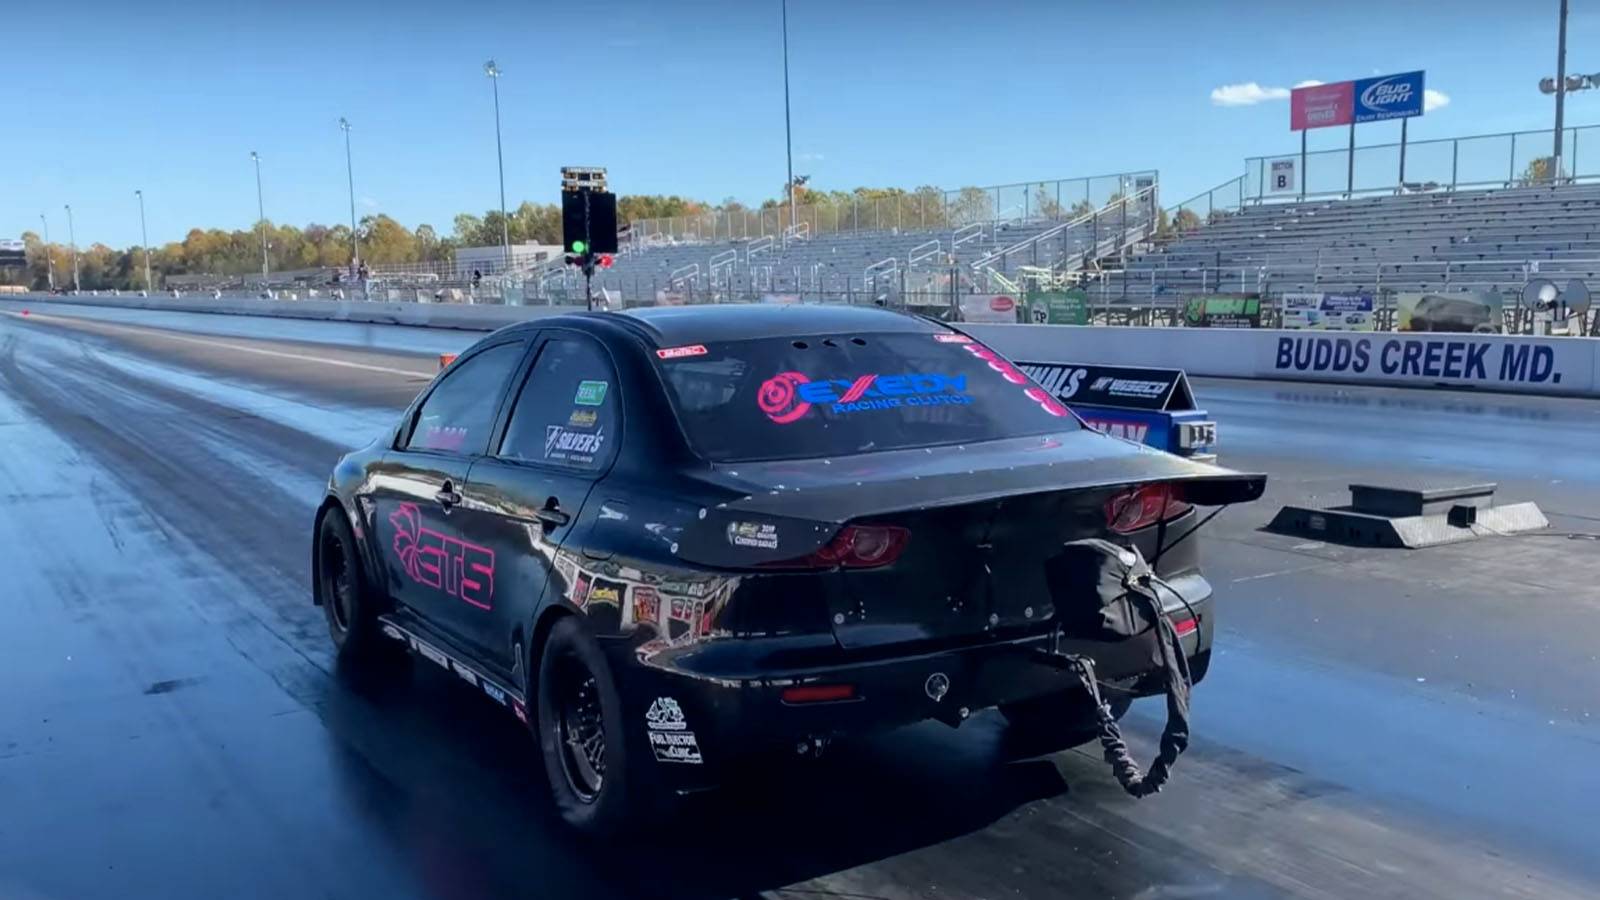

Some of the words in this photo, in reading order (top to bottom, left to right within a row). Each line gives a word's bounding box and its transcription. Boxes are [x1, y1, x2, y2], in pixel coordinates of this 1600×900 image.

[1376, 83, 1411, 96] BUD
[1367, 91, 1414, 106] LIGHT
[1278, 175, 1286, 187] B
[1276, 337, 1371, 373] BUDDS
[1380, 340, 1491, 380] CREEK
[1499, 344, 1562, 383] MD.
[832, 399, 902, 414] RACING
[906, 394, 975, 407] CLUTCH
[414, 528, 495, 610] ETS
